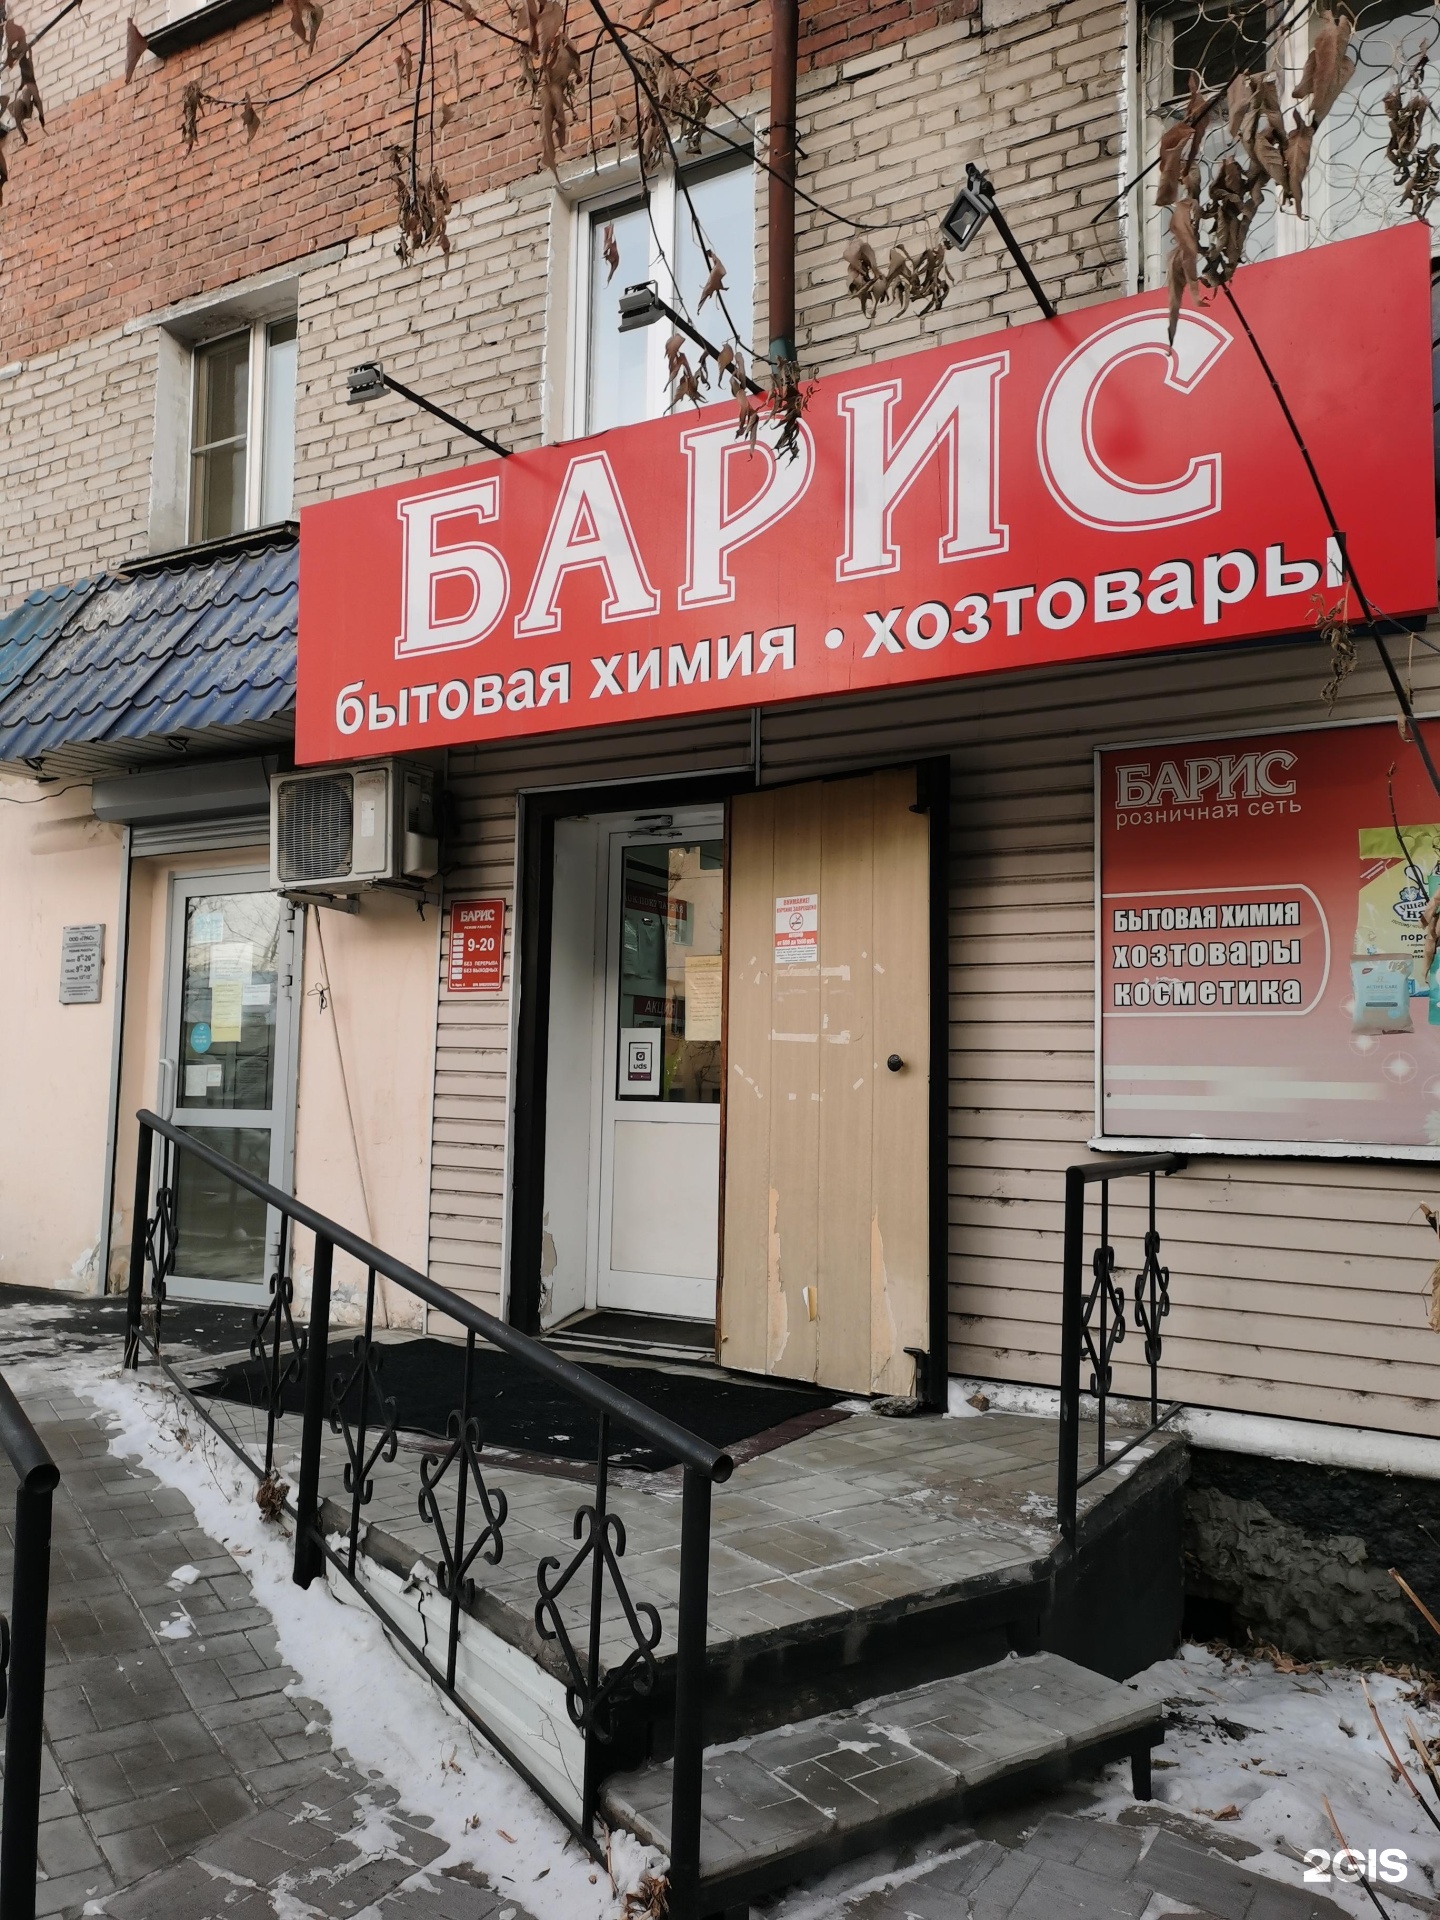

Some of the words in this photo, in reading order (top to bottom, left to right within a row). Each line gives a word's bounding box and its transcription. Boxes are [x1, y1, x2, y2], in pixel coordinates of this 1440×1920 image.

[394, 306, 1234, 660] БАРИС
[334, 663, 571, 735] бытовая
[589, 624, 796, 699] химия
[862, 535, 1346, 658] хозтовары
[1115, 749, 1299, 809] БАРИС
[1116, 803, 1239, 830] розничная
[1248, 799, 1302, 817] сеть
[460, 909, 495, 922] БАРИС
[1113, 905, 1217, 932] БЫТОВАЯ
[1220, 901, 1302, 928] ХИМИЯ
[467, 937, 495, 952] 9-20
[1112, 939, 1301, 968] хозтовары
[1113, 978, 1301, 1007] косметика
